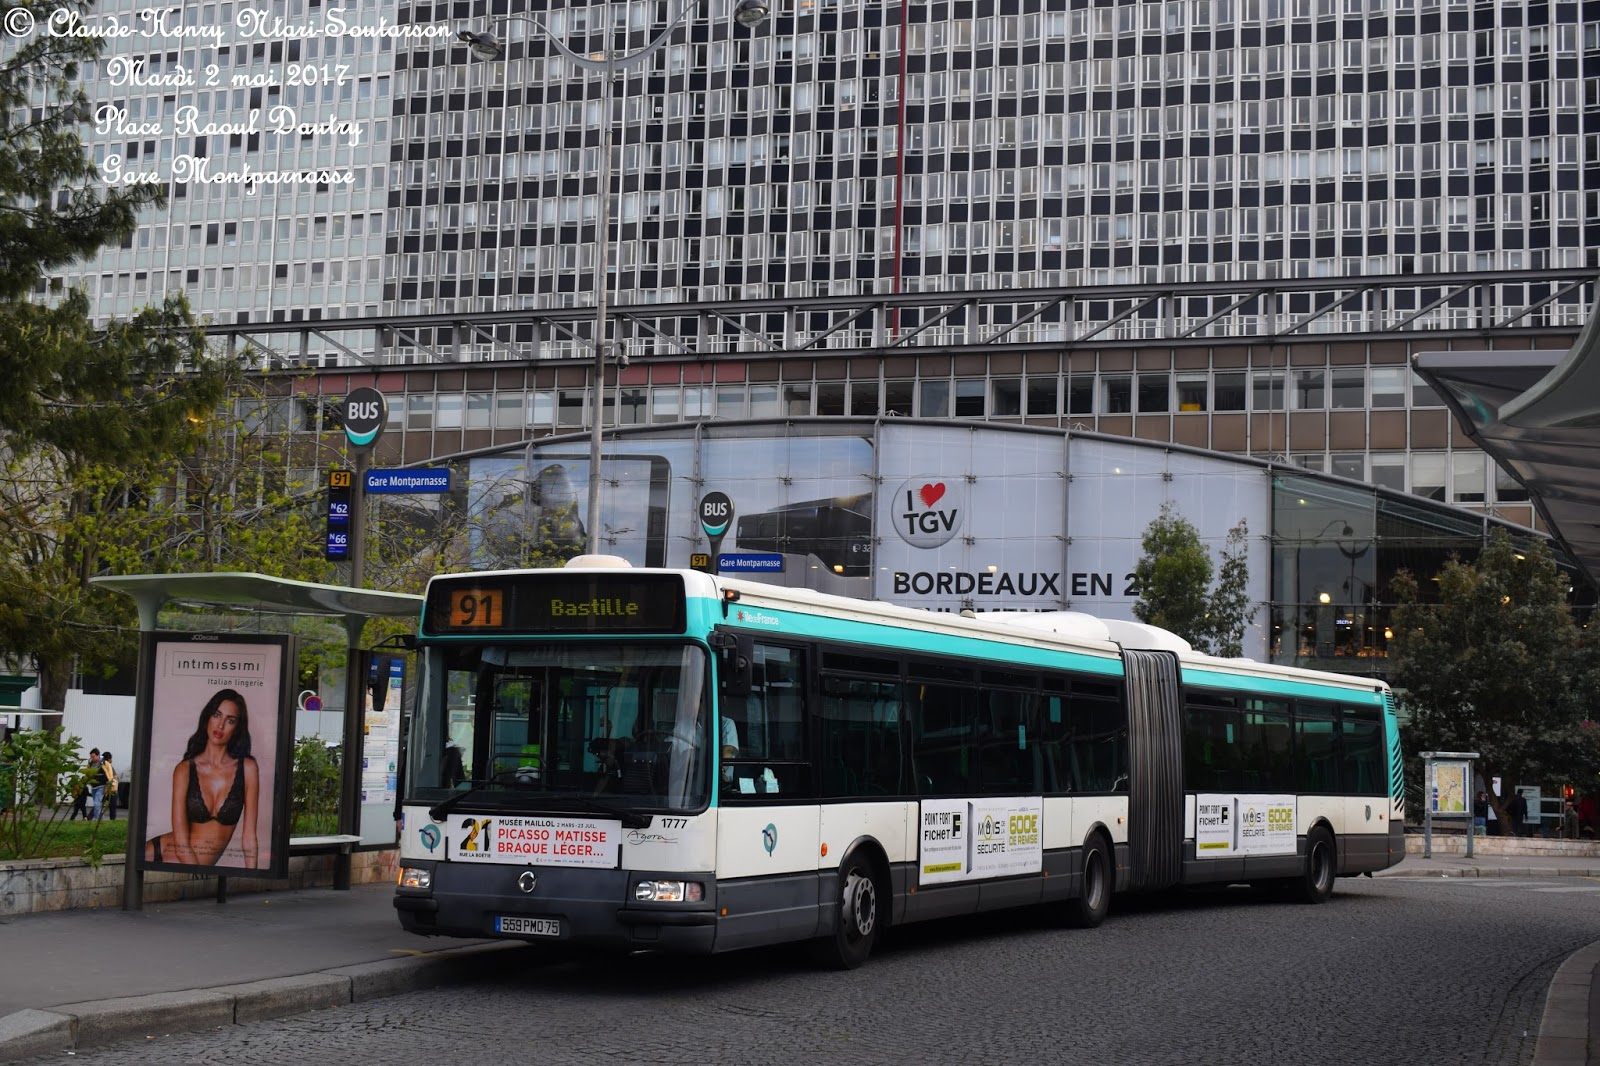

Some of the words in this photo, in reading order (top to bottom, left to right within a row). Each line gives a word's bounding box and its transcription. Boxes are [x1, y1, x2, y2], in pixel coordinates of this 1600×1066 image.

[348, 401, 379, 420] BUS
[334, 473, 348, 486] 91
[368, 476, 388, 487] Gare
[389, 476, 447, 488] Montparnasse
[907, 490, 913, 511] I
[704, 502, 728, 517] BUS
[903, 508, 958, 535] TGV
[694, 556, 705, 565] 91
[720, 559, 736, 568] Gare
[736, 559, 781, 569] Montparnasse
[894, 572, 1060, 596] BORDEAUX
[1071, 573, 1112, 596] EN
[459, 594, 493, 625] 91
[551, 598, 639, 617] Bastille
[178, 659, 260, 672] intimissimi
[207, 678, 232, 686] Italian
[235, 679, 264, 688] lingerie
[498, 819, 523, 827] MUSÉE
[524, 820, 556, 828] MAILLOL
[661, 818, 690, 829] 1777
[925, 812, 938, 826] POINT
[939, 812, 950, 825] FORT
[1009, 814, 1038, 835] 600€
[460, 818, 492, 852] 21
[498, 828, 550, 841] PICASSO
[555, 830, 607, 843] MATISSE
[1018, 834, 1038, 846] REMISE
[498, 842, 548, 855] BRAQUE
[502, 918, 522, 932] 559
[545, 921, 559, 934] 75
